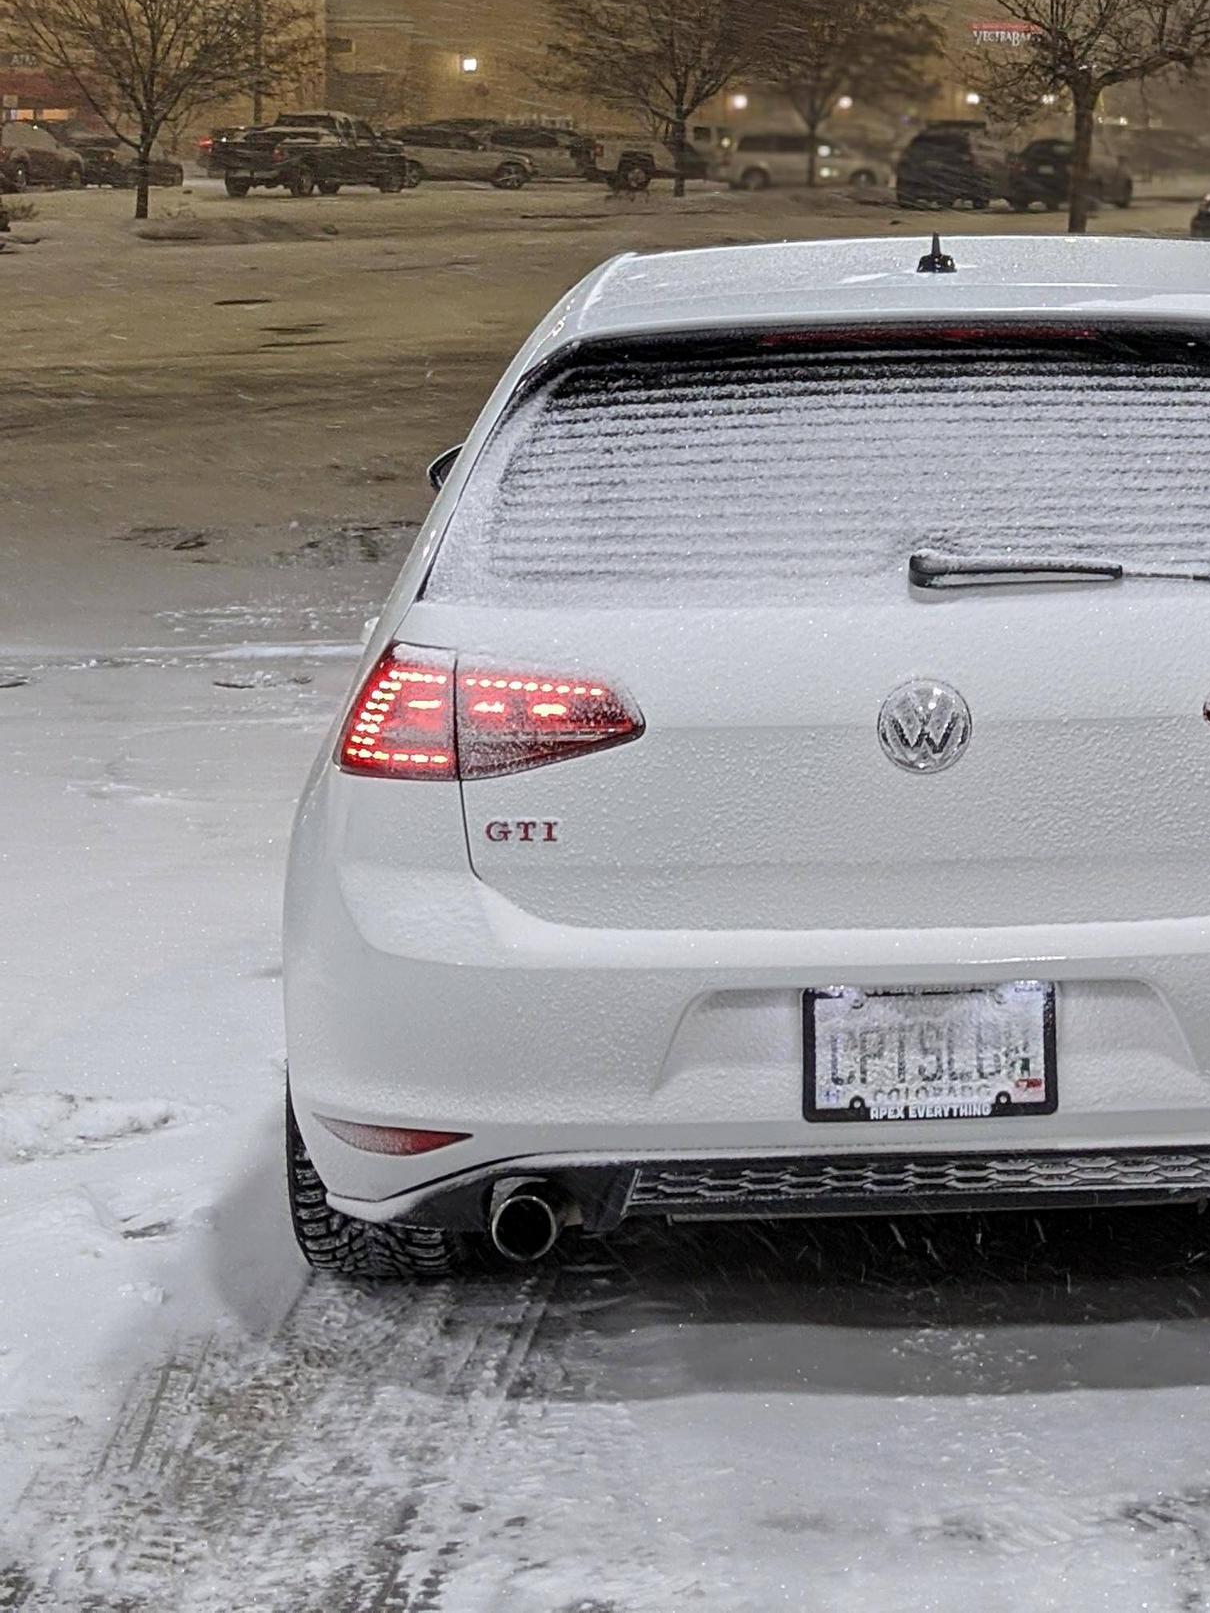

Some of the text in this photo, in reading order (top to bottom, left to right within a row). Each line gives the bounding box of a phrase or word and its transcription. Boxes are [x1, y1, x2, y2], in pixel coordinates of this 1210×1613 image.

[485, 821, 559, 842] GTI
[870, 1103, 992, 1120] APEX EVERYTHING
